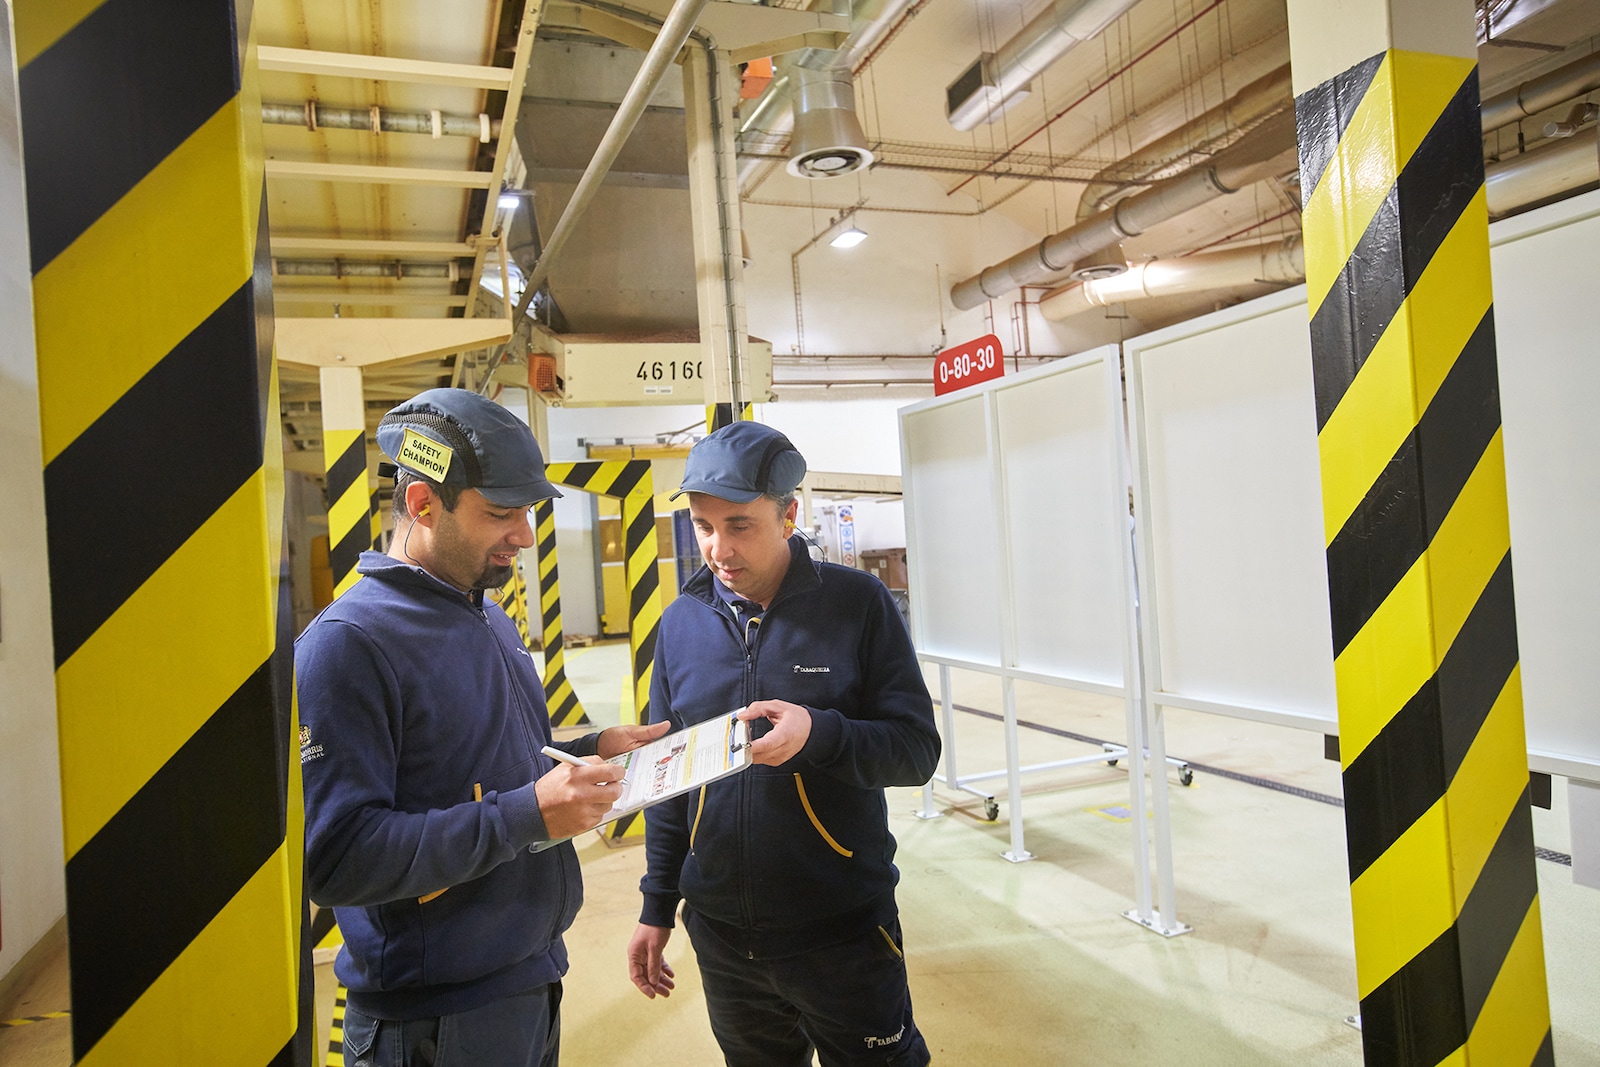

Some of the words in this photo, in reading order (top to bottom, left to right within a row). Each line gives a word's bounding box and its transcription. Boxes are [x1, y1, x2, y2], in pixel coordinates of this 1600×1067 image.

[940, 344, 995, 384] 0-80-30
[403, 447, 445, 475] CHAMPION
[412, 439, 441, 460] SAFETY
